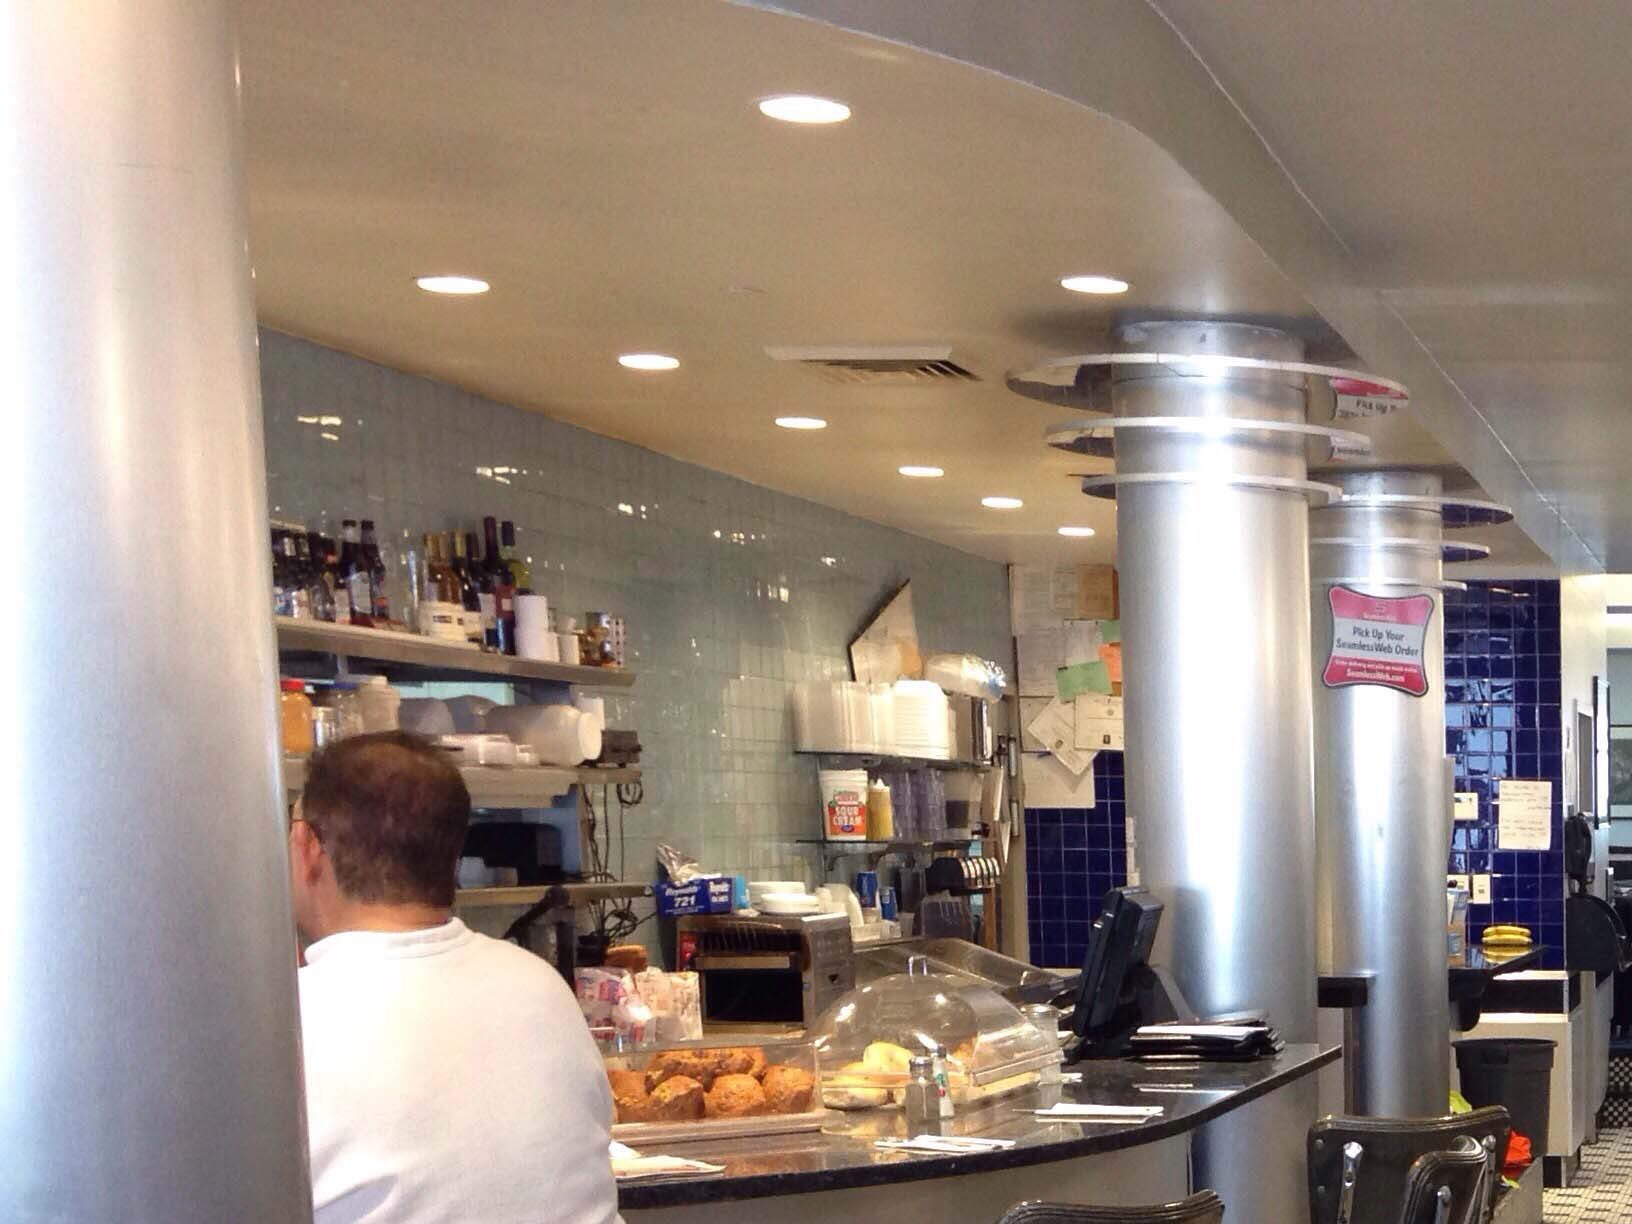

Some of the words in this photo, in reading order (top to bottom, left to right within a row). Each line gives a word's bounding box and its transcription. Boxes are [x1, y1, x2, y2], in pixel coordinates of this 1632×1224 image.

[1352, 626, 1370, 638] Pick
[1372, 629, 1384, 640] Up
[1385, 630, 1405, 641] Your
[1395, 644, 1419, 656] Order
[835, 806, 861, 816] SOUR
[833, 815, 863, 826] CREAM
[674, 895, 696, 907] 721
